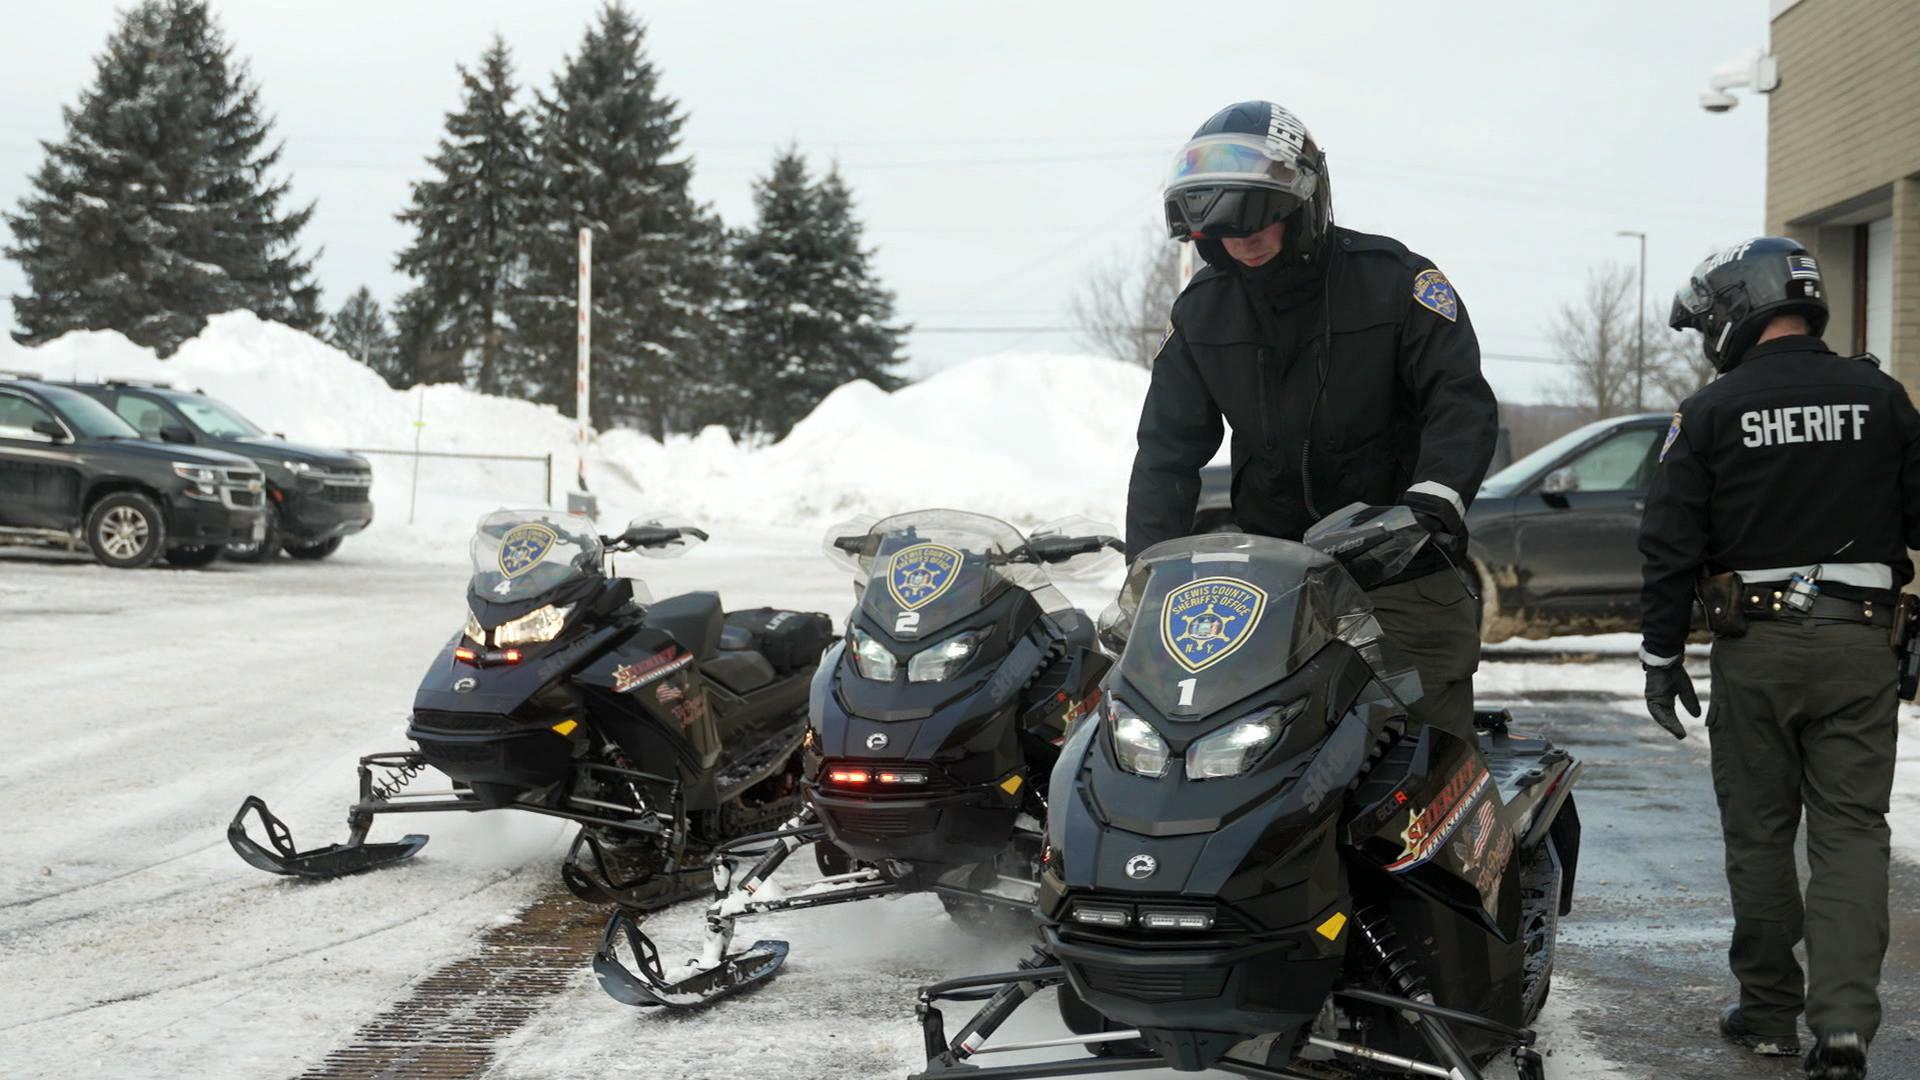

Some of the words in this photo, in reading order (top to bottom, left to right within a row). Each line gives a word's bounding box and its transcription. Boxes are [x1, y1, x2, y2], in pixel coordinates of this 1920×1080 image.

[1741, 404, 1870, 448] SHERIFF
[494, 580, 511, 595] 4
[1178, 586, 1210, 602] LEWIS
[1212, 585, 1252, 602] COUNTY
[1172, 595, 1219, 615] SHERIFF'S
[1220, 597, 1250, 616] OFFICE
[895, 611, 920, 632] 2
[1177, 678, 1197, 705] 1
